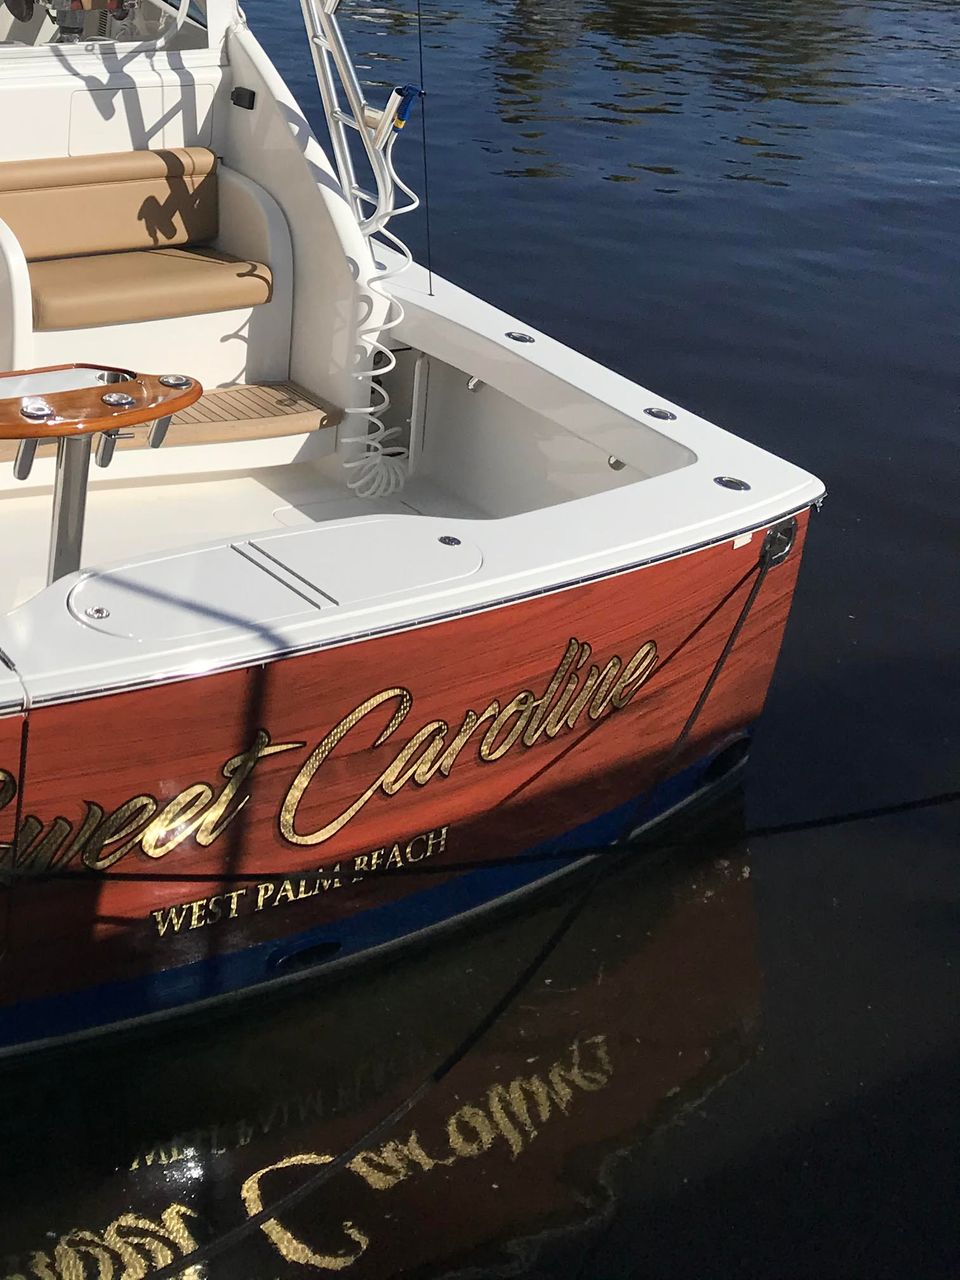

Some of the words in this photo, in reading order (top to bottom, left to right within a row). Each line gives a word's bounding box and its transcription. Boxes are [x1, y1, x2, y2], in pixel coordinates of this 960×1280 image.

[279, 637, 660, 846] Caroline
[152, 889, 246, 937] WEST
[254, 863, 343, 912] PALM
